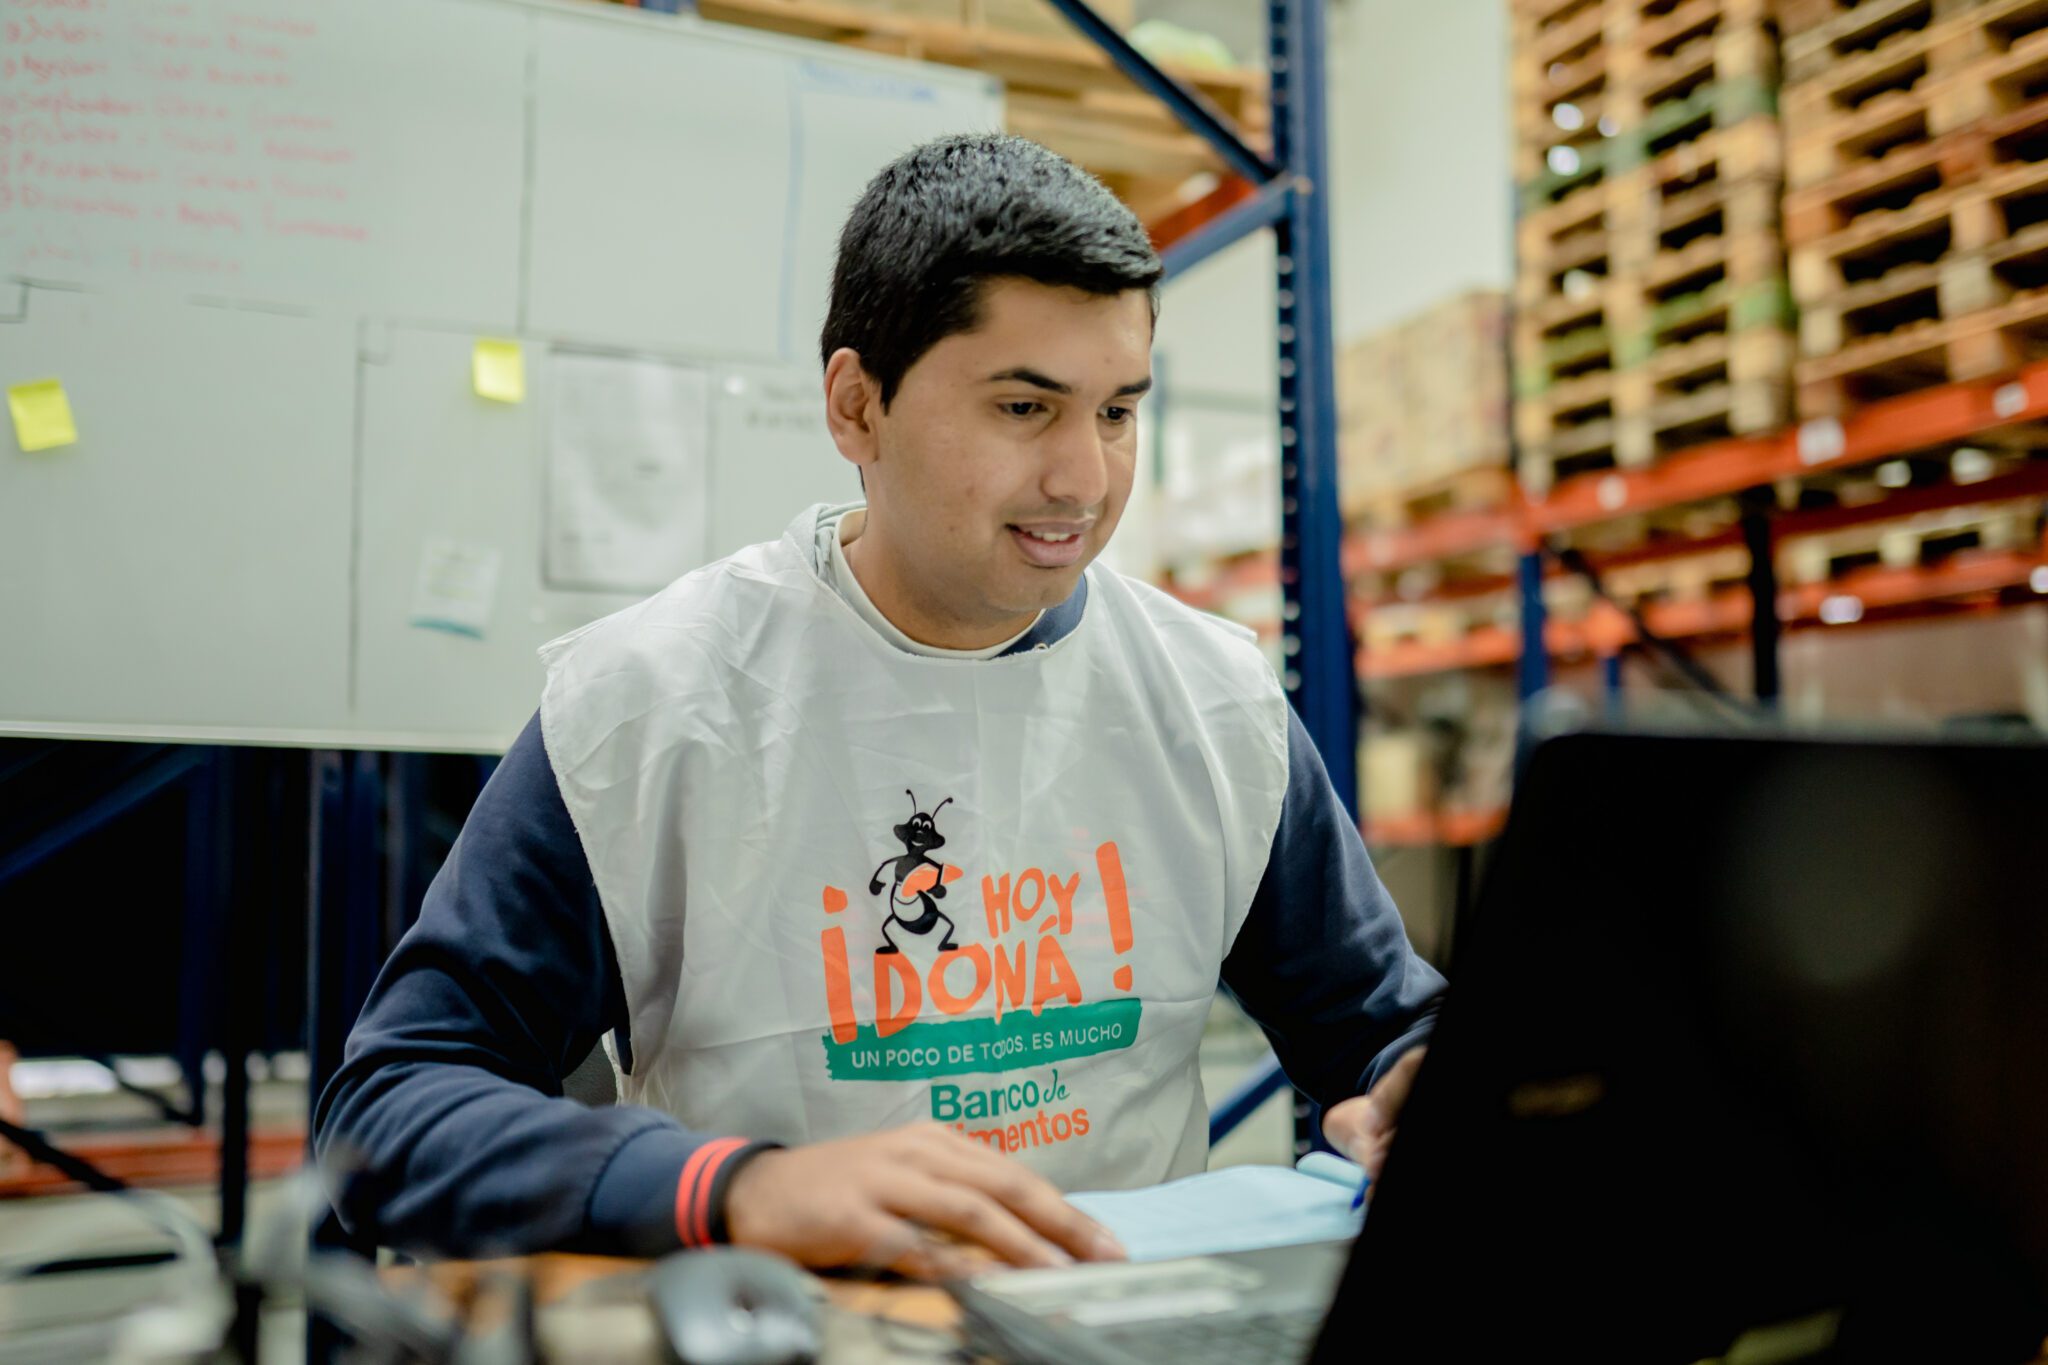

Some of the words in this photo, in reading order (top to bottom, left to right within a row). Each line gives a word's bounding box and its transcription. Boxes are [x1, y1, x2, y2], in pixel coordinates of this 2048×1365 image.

[851, 1050, 880, 1068] UN
[886, 1046, 940, 1067] POCO
[948, 1043, 975, 1064] DE
[1032, 1031, 1054, 1050] ES
[1059, 1023, 1123, 1045] MUCHO
[931, 1080, 1040, 1121] Banco
[1043, 1068, 1070, 1103] de
